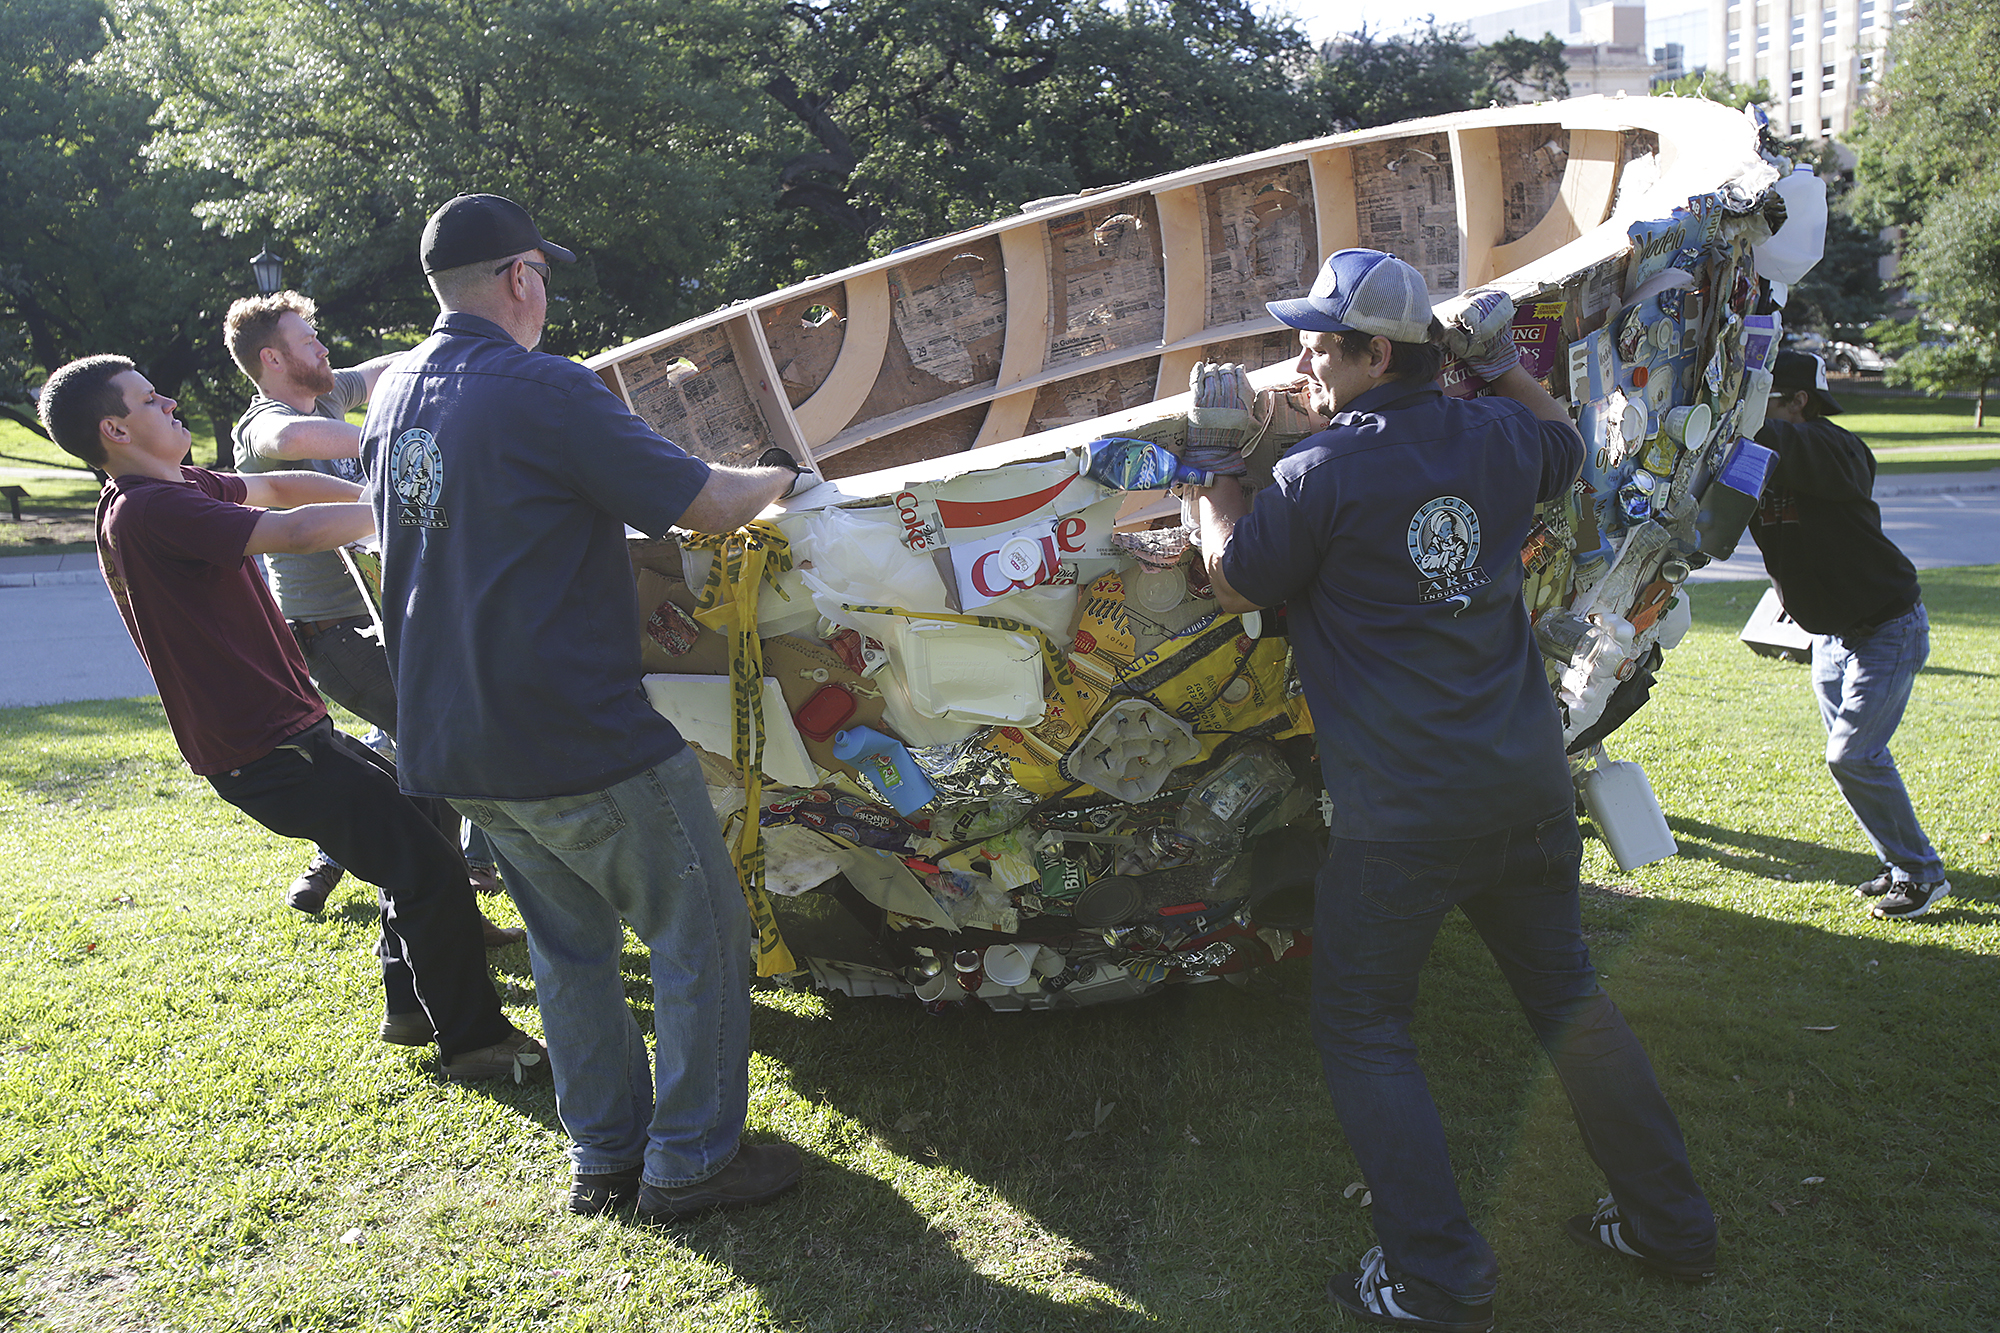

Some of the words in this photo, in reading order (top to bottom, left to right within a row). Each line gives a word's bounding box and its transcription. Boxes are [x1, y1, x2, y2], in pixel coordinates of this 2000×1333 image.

[1691, 200, 1701, 215] 18
[1060, 337, 1079, 347] Guide
[401, 506, 439, 520] ART
[896, 492, 926, 552] Coke
[1442, 497, 1479, 552] GENIE
[922, 524, 935, 546] Diet
[1056, 569, 1076, 578] Diet
[1424, 570, 1479, 594] ART
[1424, 579, 1486, 601] INDUSTRIES
[1105, 634, 1129, 650] ENJOY
[1194, 683, 1208, 702] BIRDS
[1205, 704, 1217, 720] WIL
